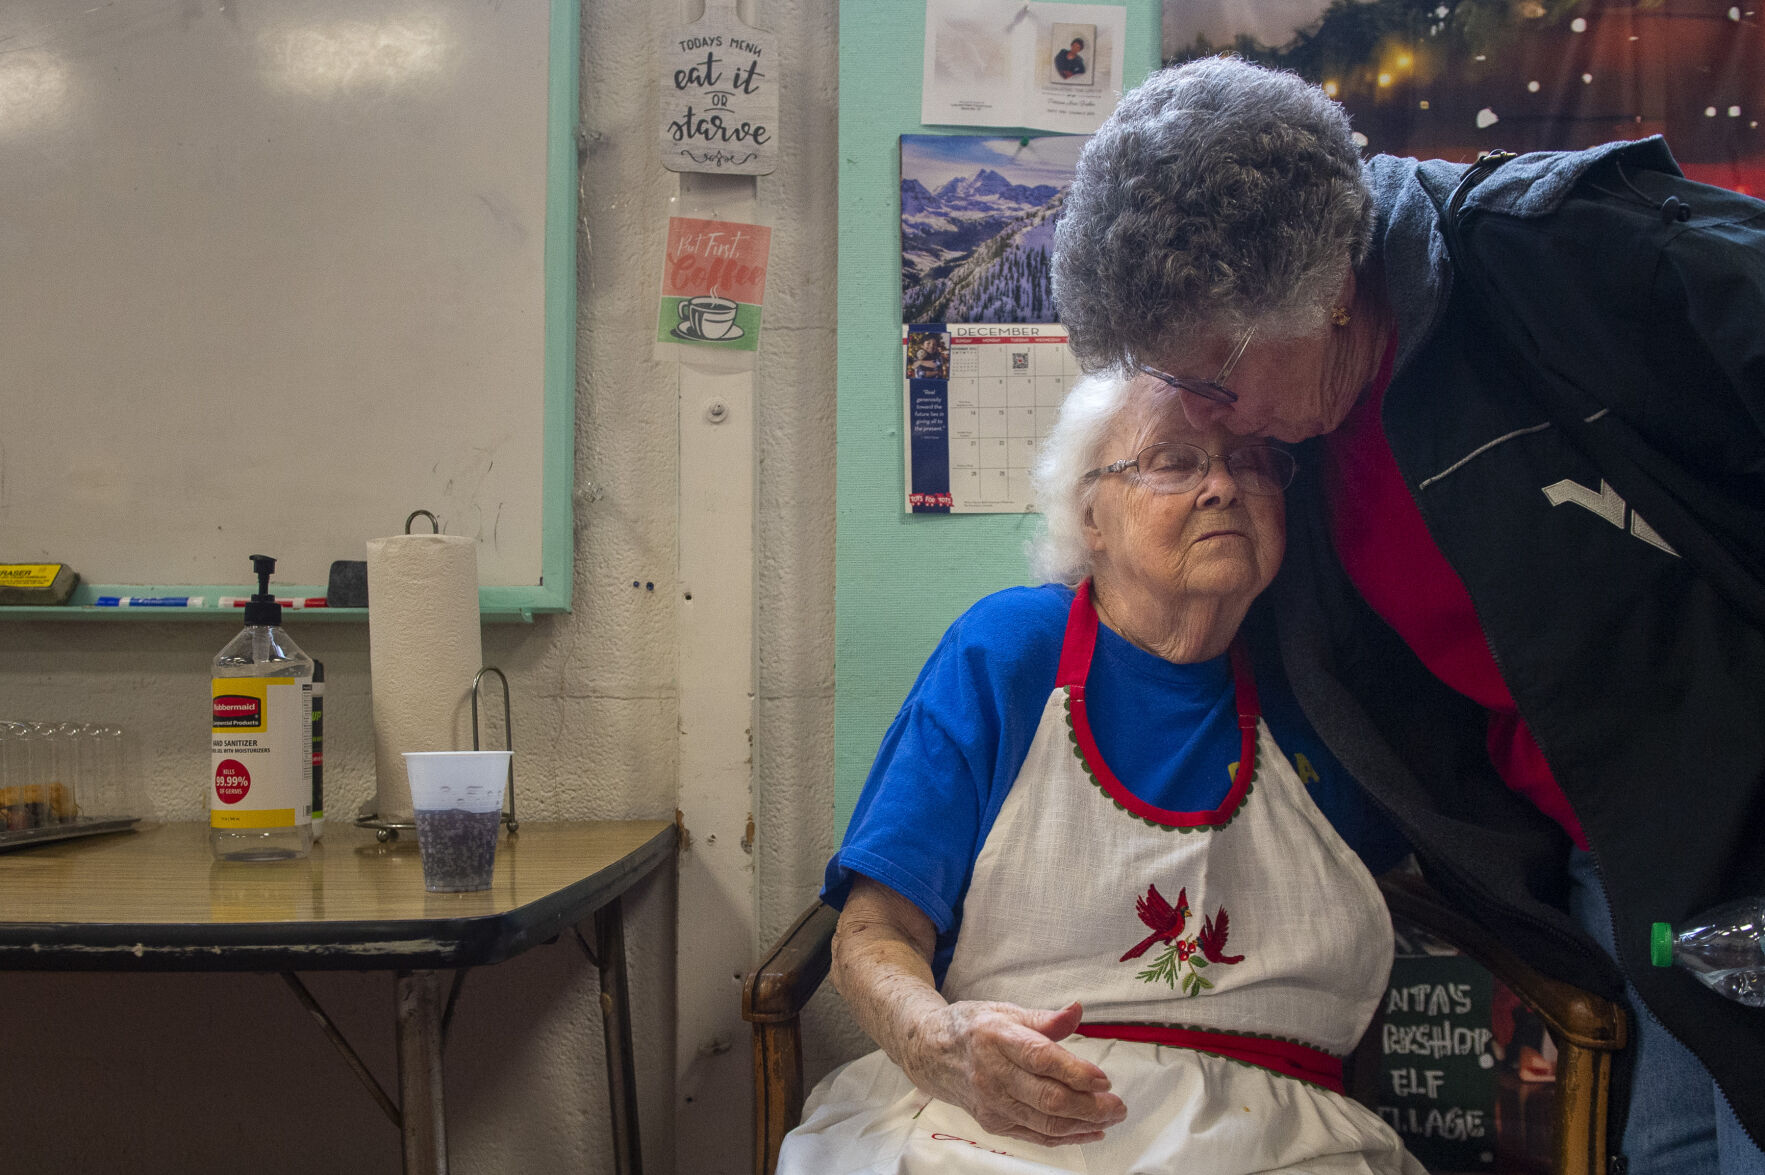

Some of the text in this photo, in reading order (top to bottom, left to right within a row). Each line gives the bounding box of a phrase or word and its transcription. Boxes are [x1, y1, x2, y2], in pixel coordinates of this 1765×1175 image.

[679, 36, 762, 57] TODAYS MENU
[674, 51, 765, 95] eat it
[712, 94, 727, 107] OR
[667, 106, 771, 145] starve
[957, 327, 1040, 337] DECEMBER
[216, 776, 249, 787] 99.99%
[1390, 1067, 1445, 1099] ELF
